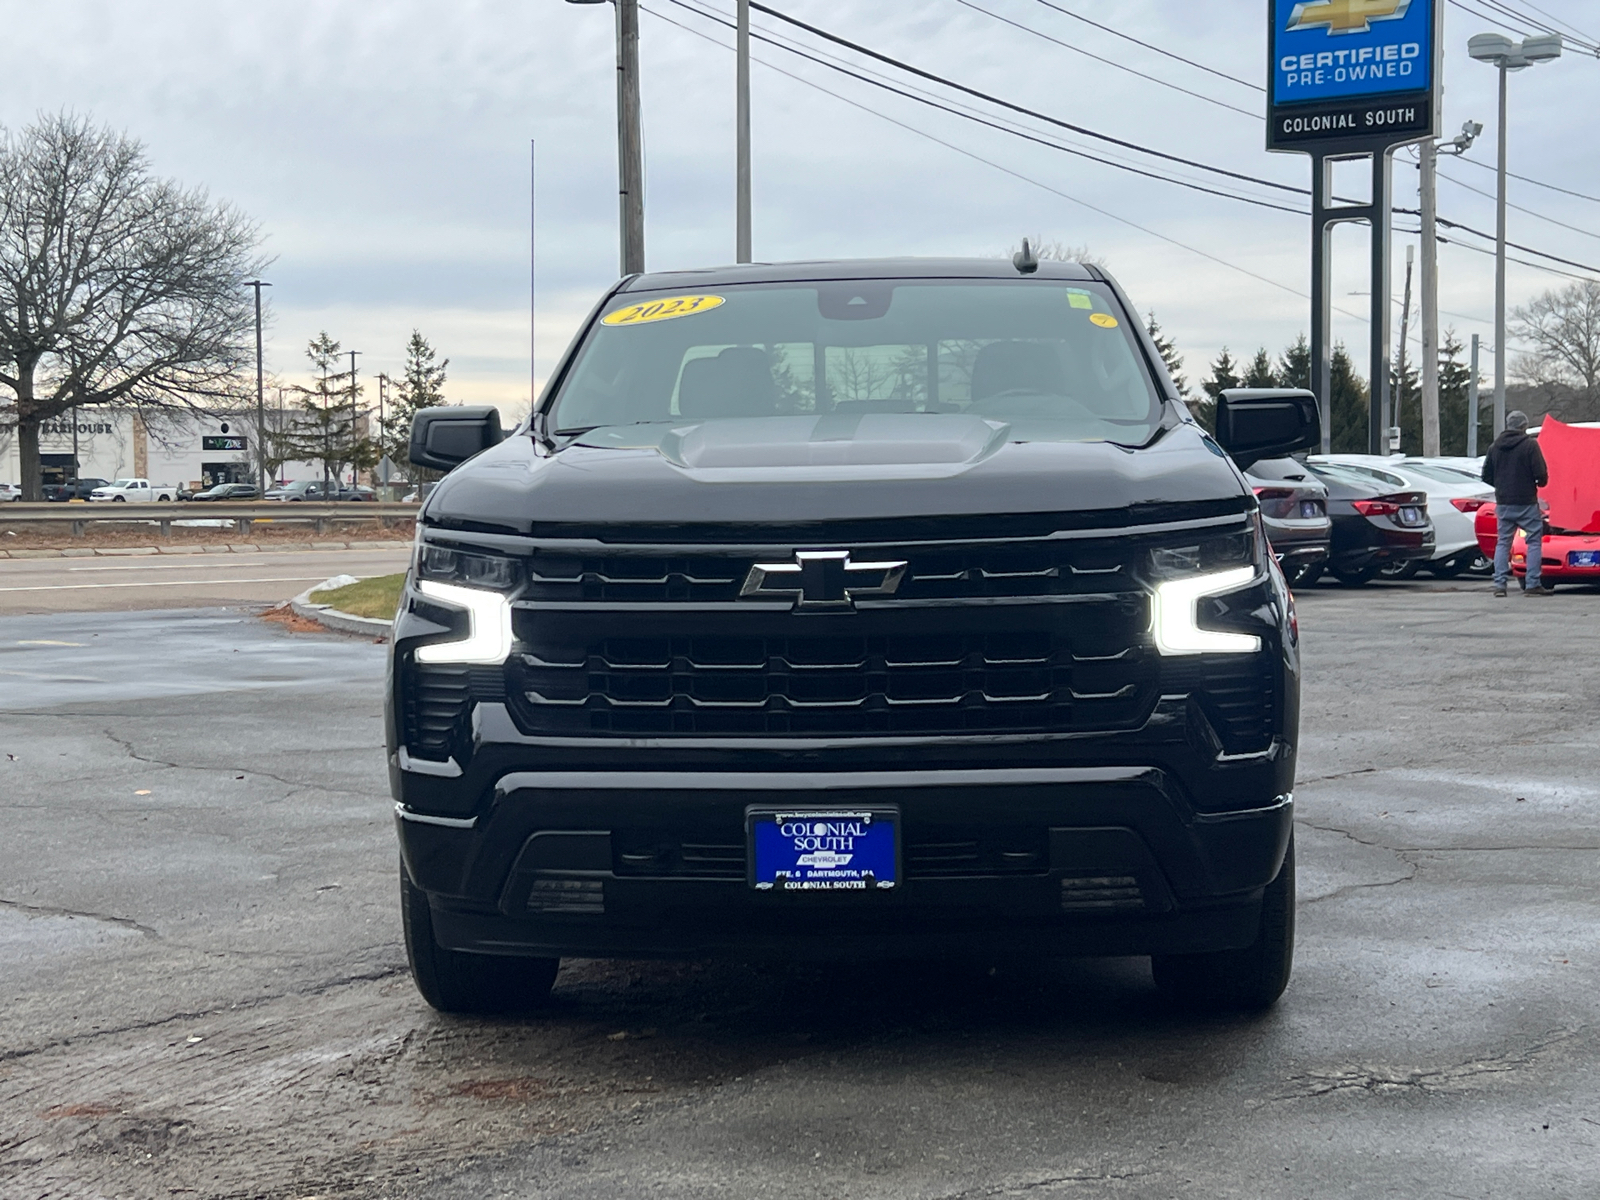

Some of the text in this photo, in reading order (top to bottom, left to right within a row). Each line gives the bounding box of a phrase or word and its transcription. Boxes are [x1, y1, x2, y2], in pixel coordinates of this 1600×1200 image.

[1280, 42, 1420, 71] CERTIFIED
[1287, 61, 1413, 87] PRE-OWNED
[1283, 108, 1415, 133] COLONIAL SOUTH
[618, 297, 705, 323] 2023
[780, 822, 868, 837] COLONIAL
[794, 836, 854, 850] SOUTH
[807, 870, 860, 878] DARTMOUTH,
[784, 880, 866, 889] COLONIAL SOUTH
